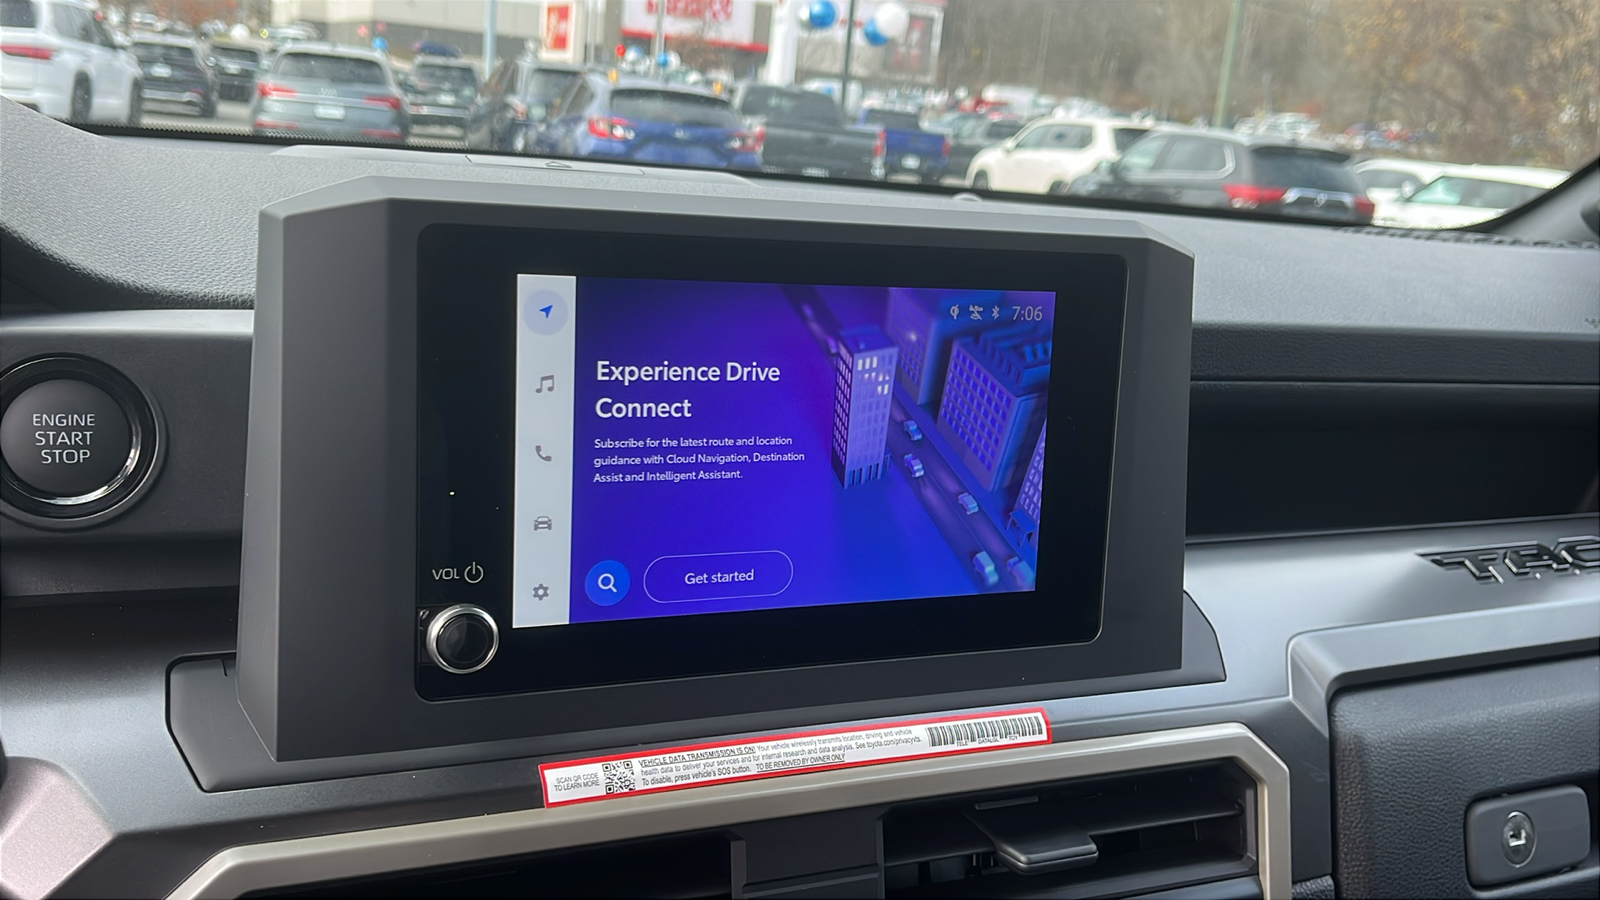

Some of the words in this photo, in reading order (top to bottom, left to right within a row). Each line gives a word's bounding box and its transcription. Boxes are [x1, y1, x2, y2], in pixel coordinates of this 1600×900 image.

[1011, 306, 1043, 321] 7:06
[596, 360, 721, 386] Experience
[726, 361, 781, 382] Drive
[595, 397, 692, 418] Connect
[33, 413, 95, 427] ENGINE
[35, 431, 94, 446] START
[594, 438, 645, 449] Subscribe
[646, 437, 660, 448] for
[662, 437, 678, 447] the
[680, 437, 708, 447] latest
[709, 437, 734, 447] route
[735, 436, 755, 446] and
[756, 436, 793, 446] location
[41, 449, 91, 464] STOP
[593, 455, 642, 468] guidance
[643, 455, 664, 465] with
[666, 454, 696, 464] Cloud
[697, 453, 751, 465] Navigation,
[753, 452, 805, 463] Destination
[593, 472, 623, 483] Assist
[624, 472, 645, 482] and
[646, 471, 696, 483] Intelligent
[697, 470, 743, 481] Assistant.
[432, 568, 460, 580] VOL
[684, 572, 709, 585] Get
[711, 568, 754, 583] started
[638, 757, 667, 767] VEHICLE
[668, 754, 686, 764] DATA
[686, 748, 736, 761] TRANSMISSION
[736, 747, 744, 755] IS
[744, 746, 756, 754] ON!
[757, 744, 770, 752] Your
[771, 741, 790, 750] vehicle
[791, 738, 817, 748] wirelessly
[817, 735, 843, 745] transmits
[842, 734, 865, 743] location,
[865, 731, 883, 740] driving
[895, 728, 912, 736] vehicle
[641, 767, 659, 776] health
[660, 766, 674, 774] data
[682, 763, 702, 771] deliver
[702, 761, 715, 770] your
[716, 757, 740, 767] services
[740, 755, 752, 763] and
[761, 752, 782, 760] internal
[782, 749, 807, 758] research
[807, 747, 818, 755] and
[831, 744, 854, 752] analysis.
[642, 777, 650, 786] To
[650, 775, 674, 785] disable,
[674, 773, 691, 783] press
[691, 770, 717, 780] vehicle's
[717, 766, 731, 776] SOS
[732, 765, 751, 774] button.
[773, 759, 801, 769] REMOVED
[801, 757, 810, 765] BY
[809, 754, 831, 763] OWNER
[831, 753, 846, 761] ONLY
[556, 776, 572, 784] SCAN
[582, 772, 599, 780] CODE
[563, 782, 582, 790] LEARN
[583, 779, 600, 787] MORE
